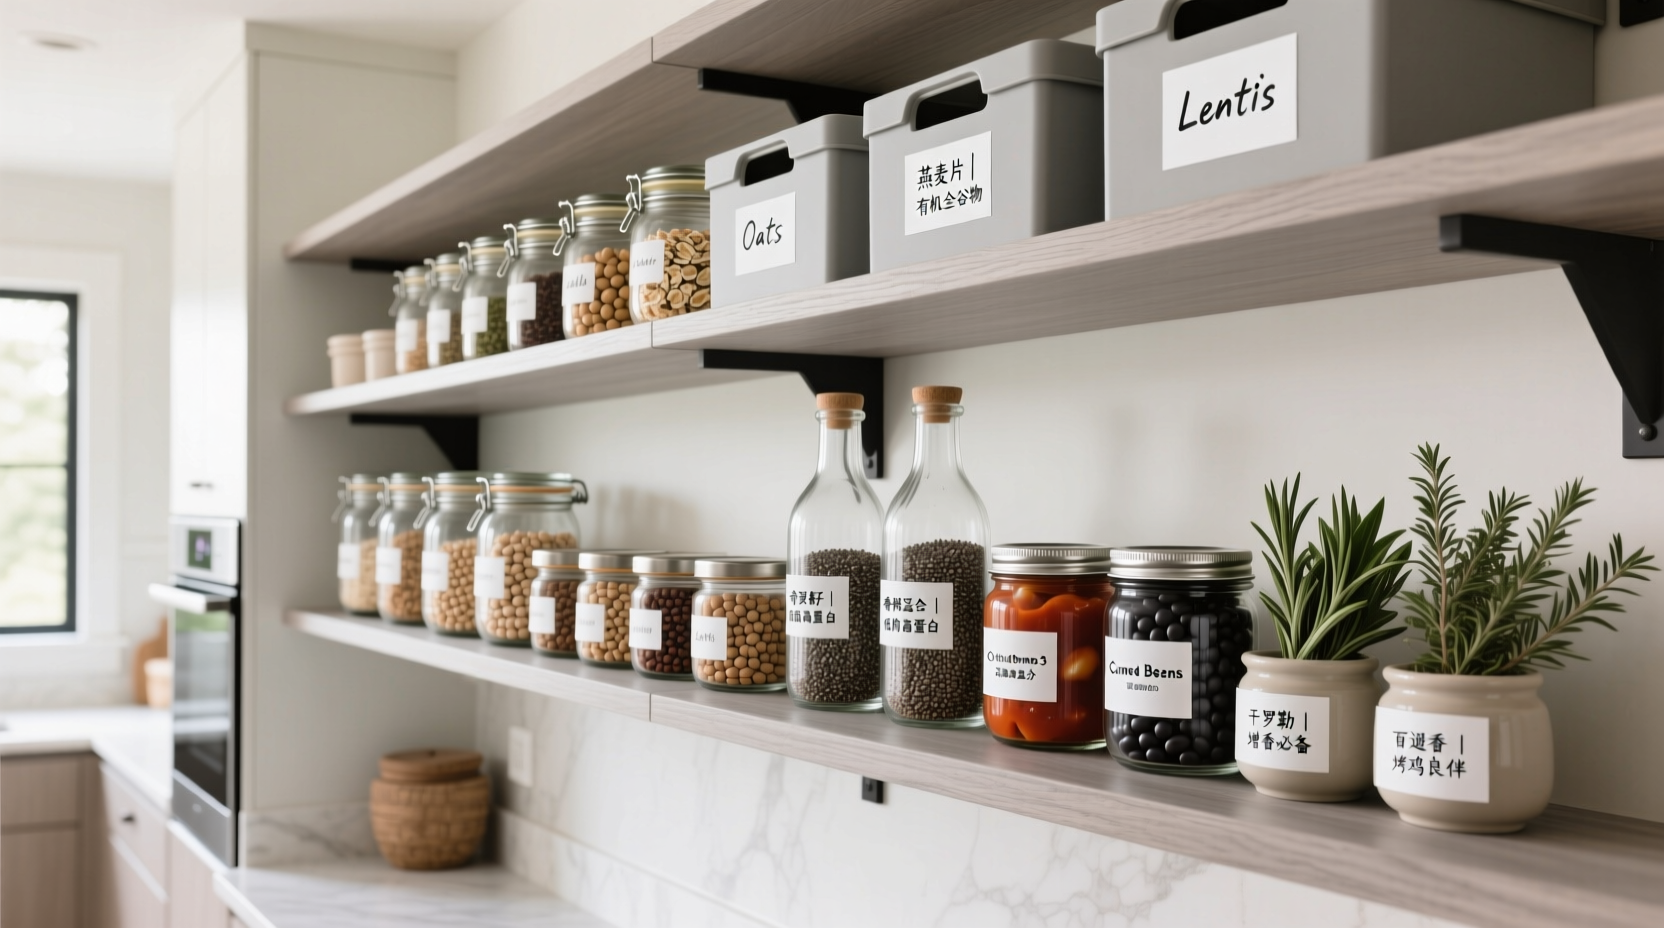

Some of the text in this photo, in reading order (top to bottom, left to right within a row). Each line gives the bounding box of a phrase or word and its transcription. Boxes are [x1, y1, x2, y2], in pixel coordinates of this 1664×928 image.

[1178, 73, 1276, 132] Lentis
[742, 219, 783, 251] Oats
[1248, 709, 1295, 731] 干罗勒
